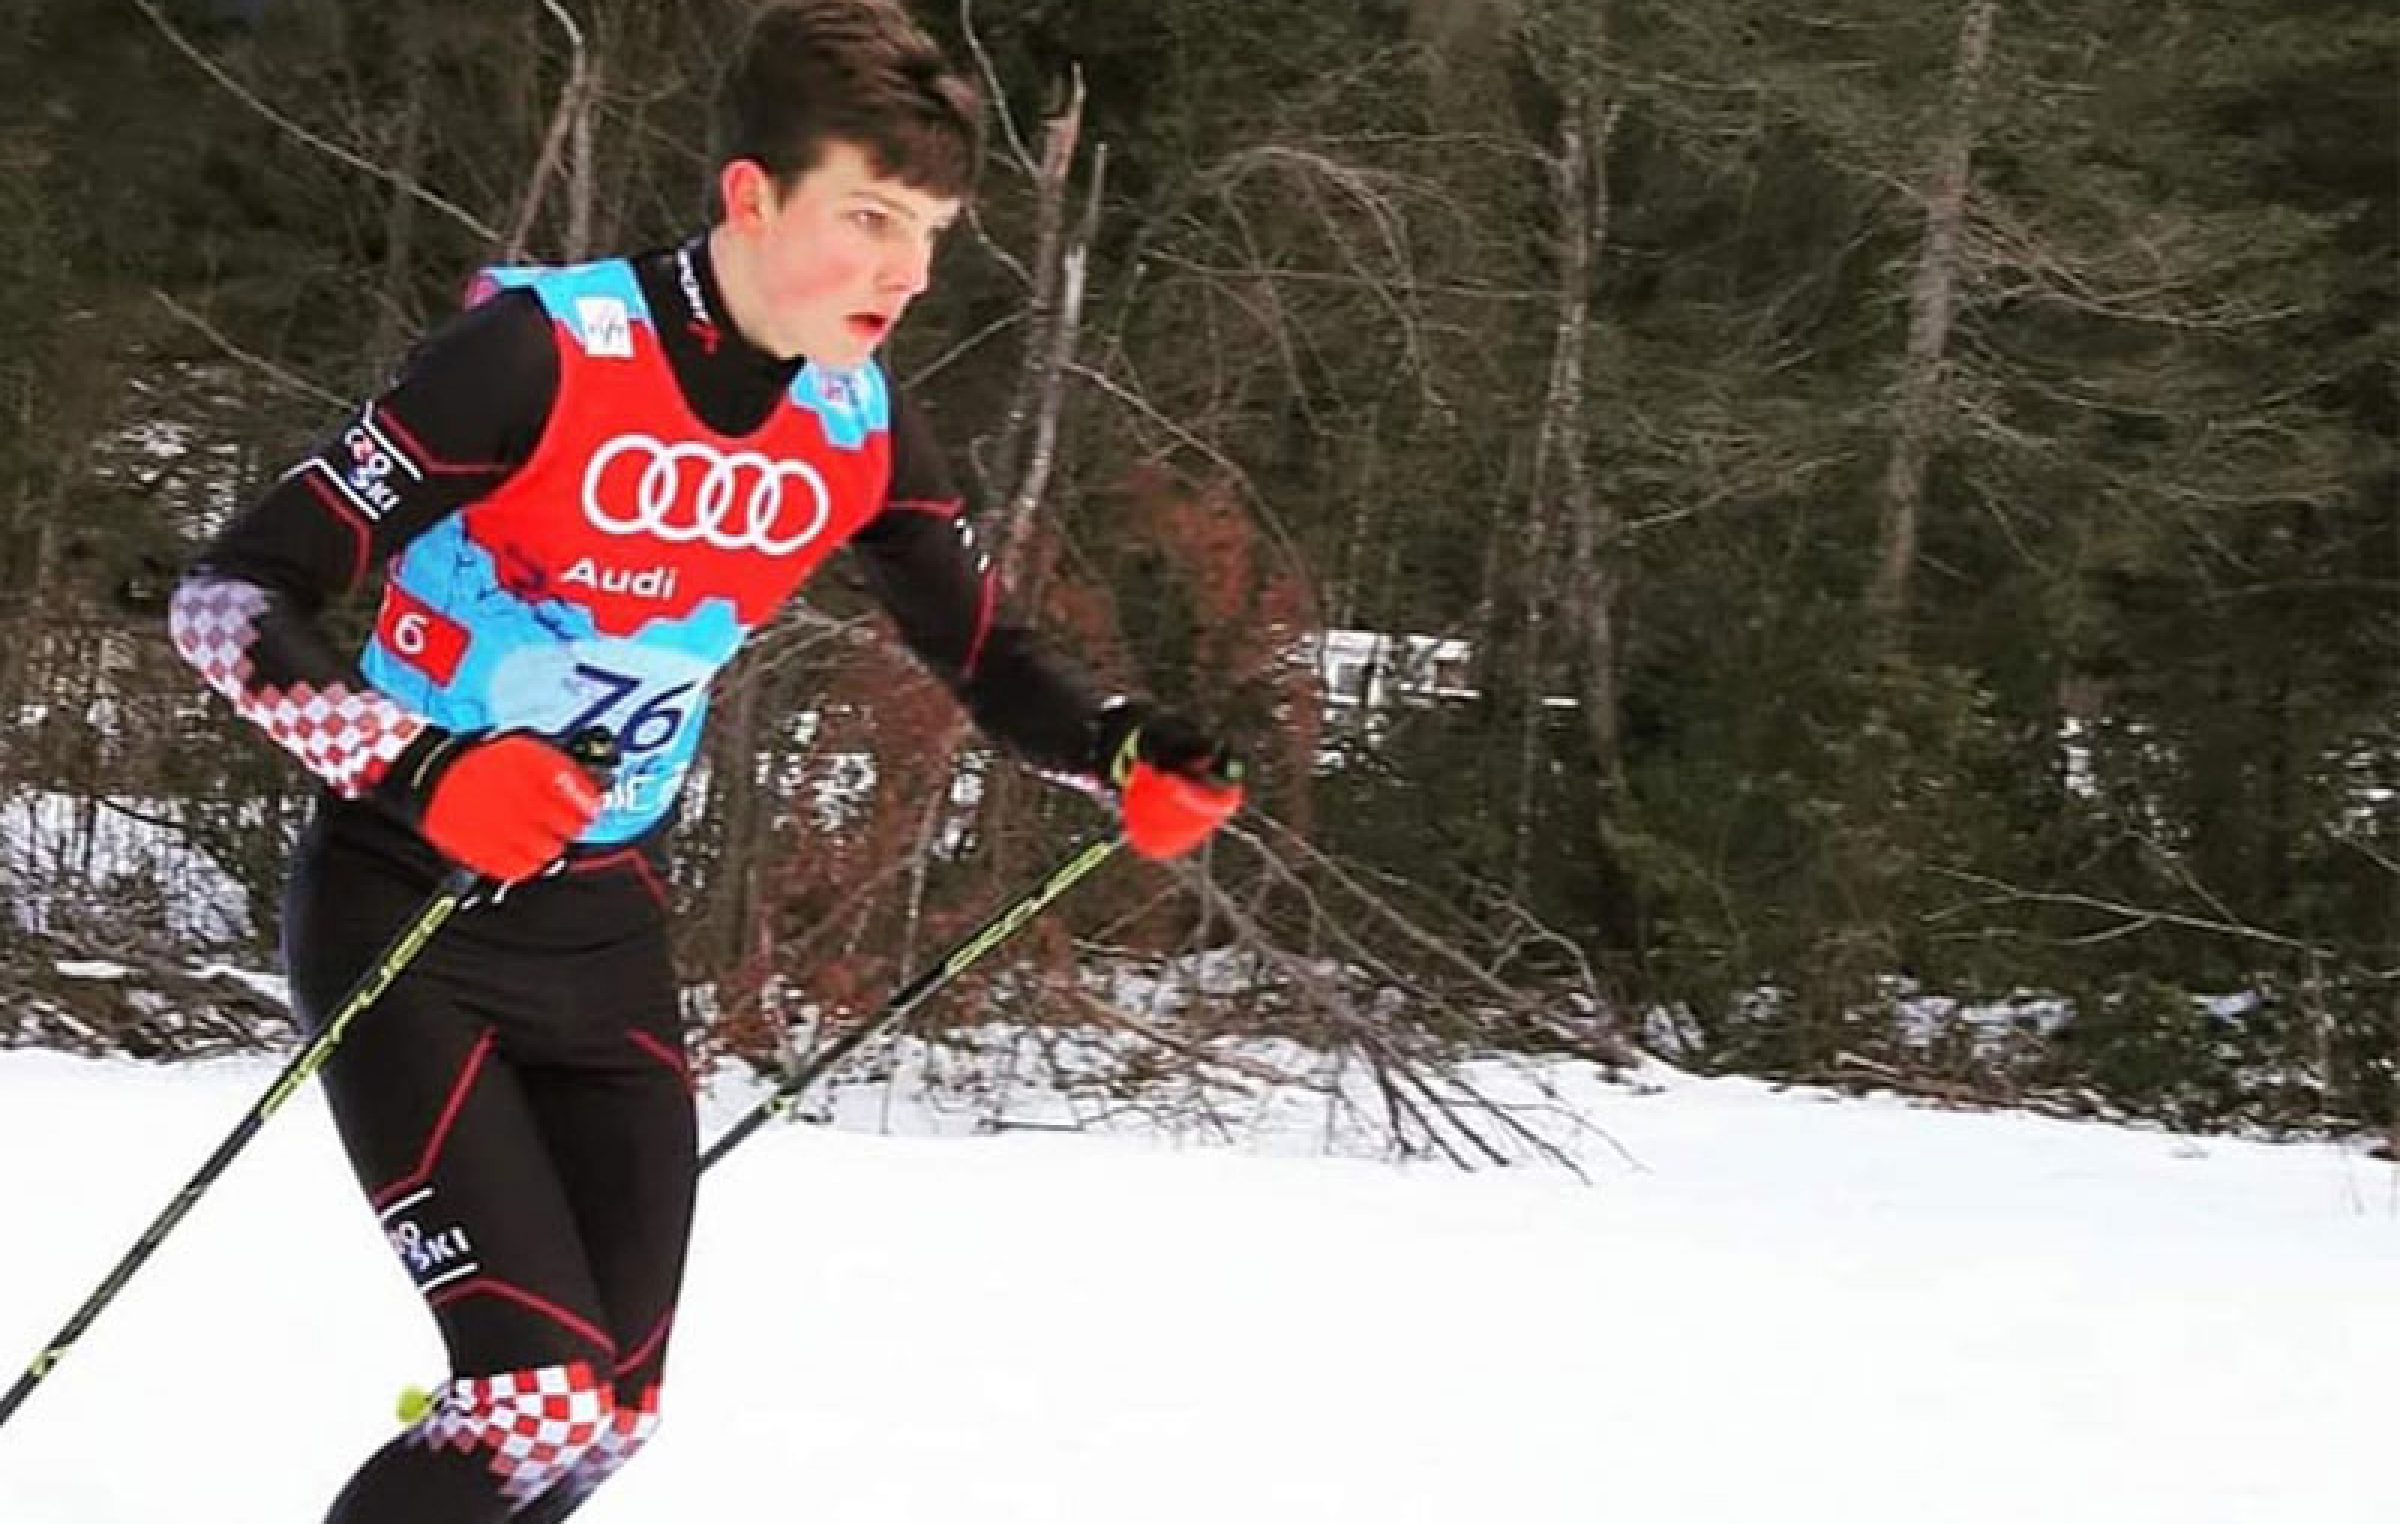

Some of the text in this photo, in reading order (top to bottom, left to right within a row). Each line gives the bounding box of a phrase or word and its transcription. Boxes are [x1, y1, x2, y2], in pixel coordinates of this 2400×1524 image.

[560, 557, 678, 601] Audi
[394, 612, 430, 654] 6
[566, 663, 697, 751] 76
[410, 1227, 471, 1271] SKI
